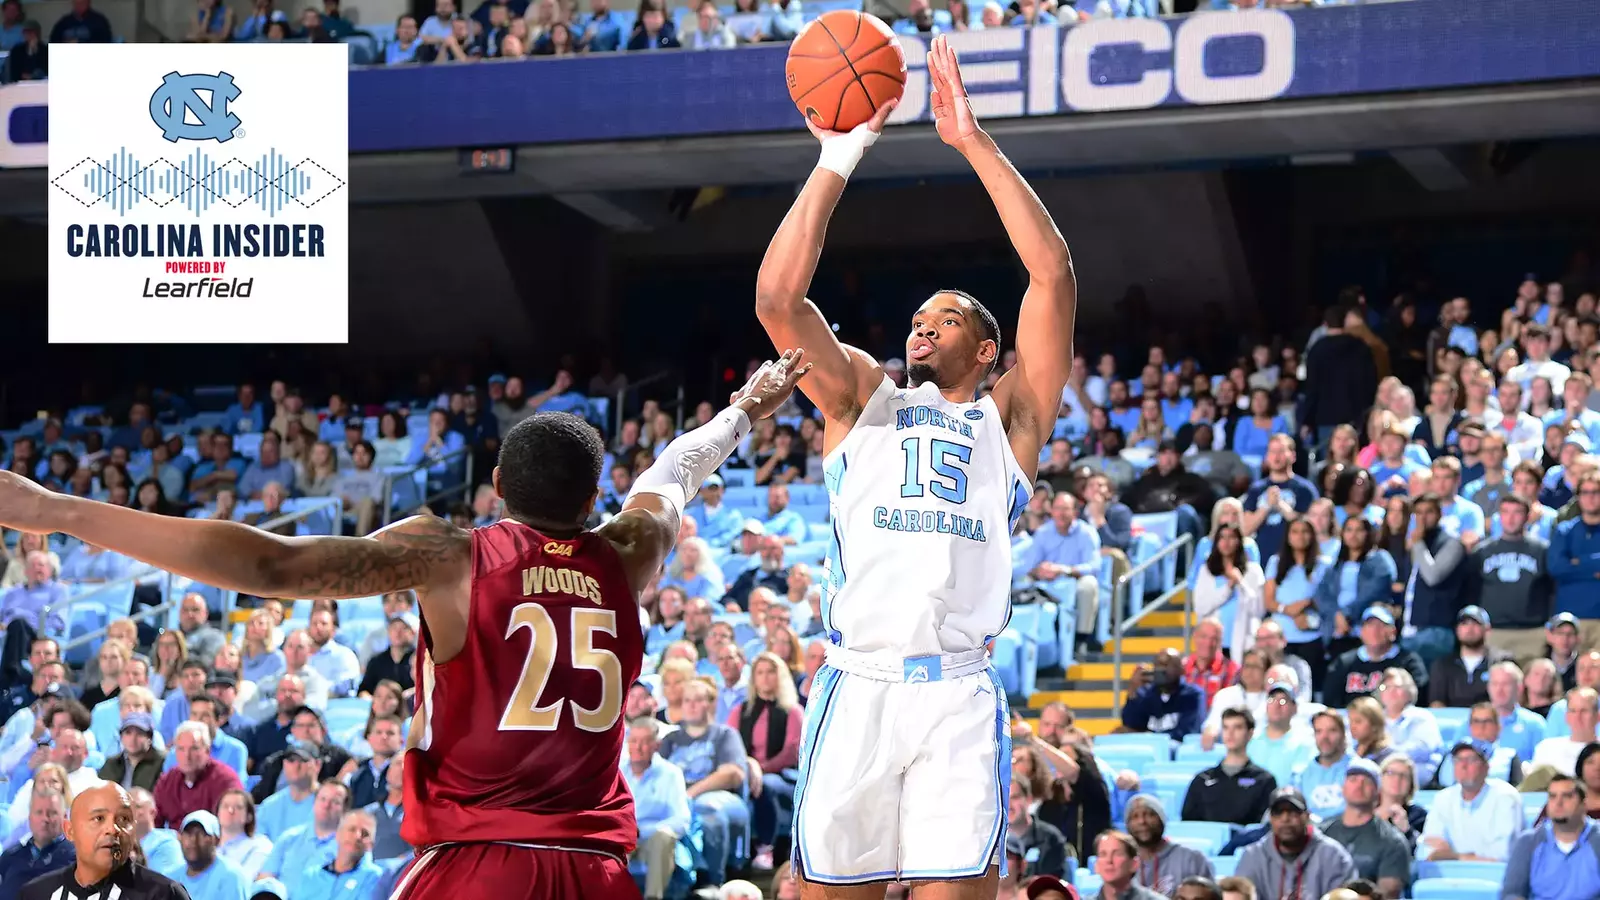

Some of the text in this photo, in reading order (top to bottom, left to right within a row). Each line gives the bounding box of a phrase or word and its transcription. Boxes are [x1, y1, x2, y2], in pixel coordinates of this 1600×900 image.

[896, 405, 975, 440] NORTH
[901, 437, 973, 504] 15
[873, 506, 986, 542] CAROLINA
[543, 541, 574, 557] CAA
[522, 565, 602, 606] WOODS
[497, 602, 623, 733] 25
